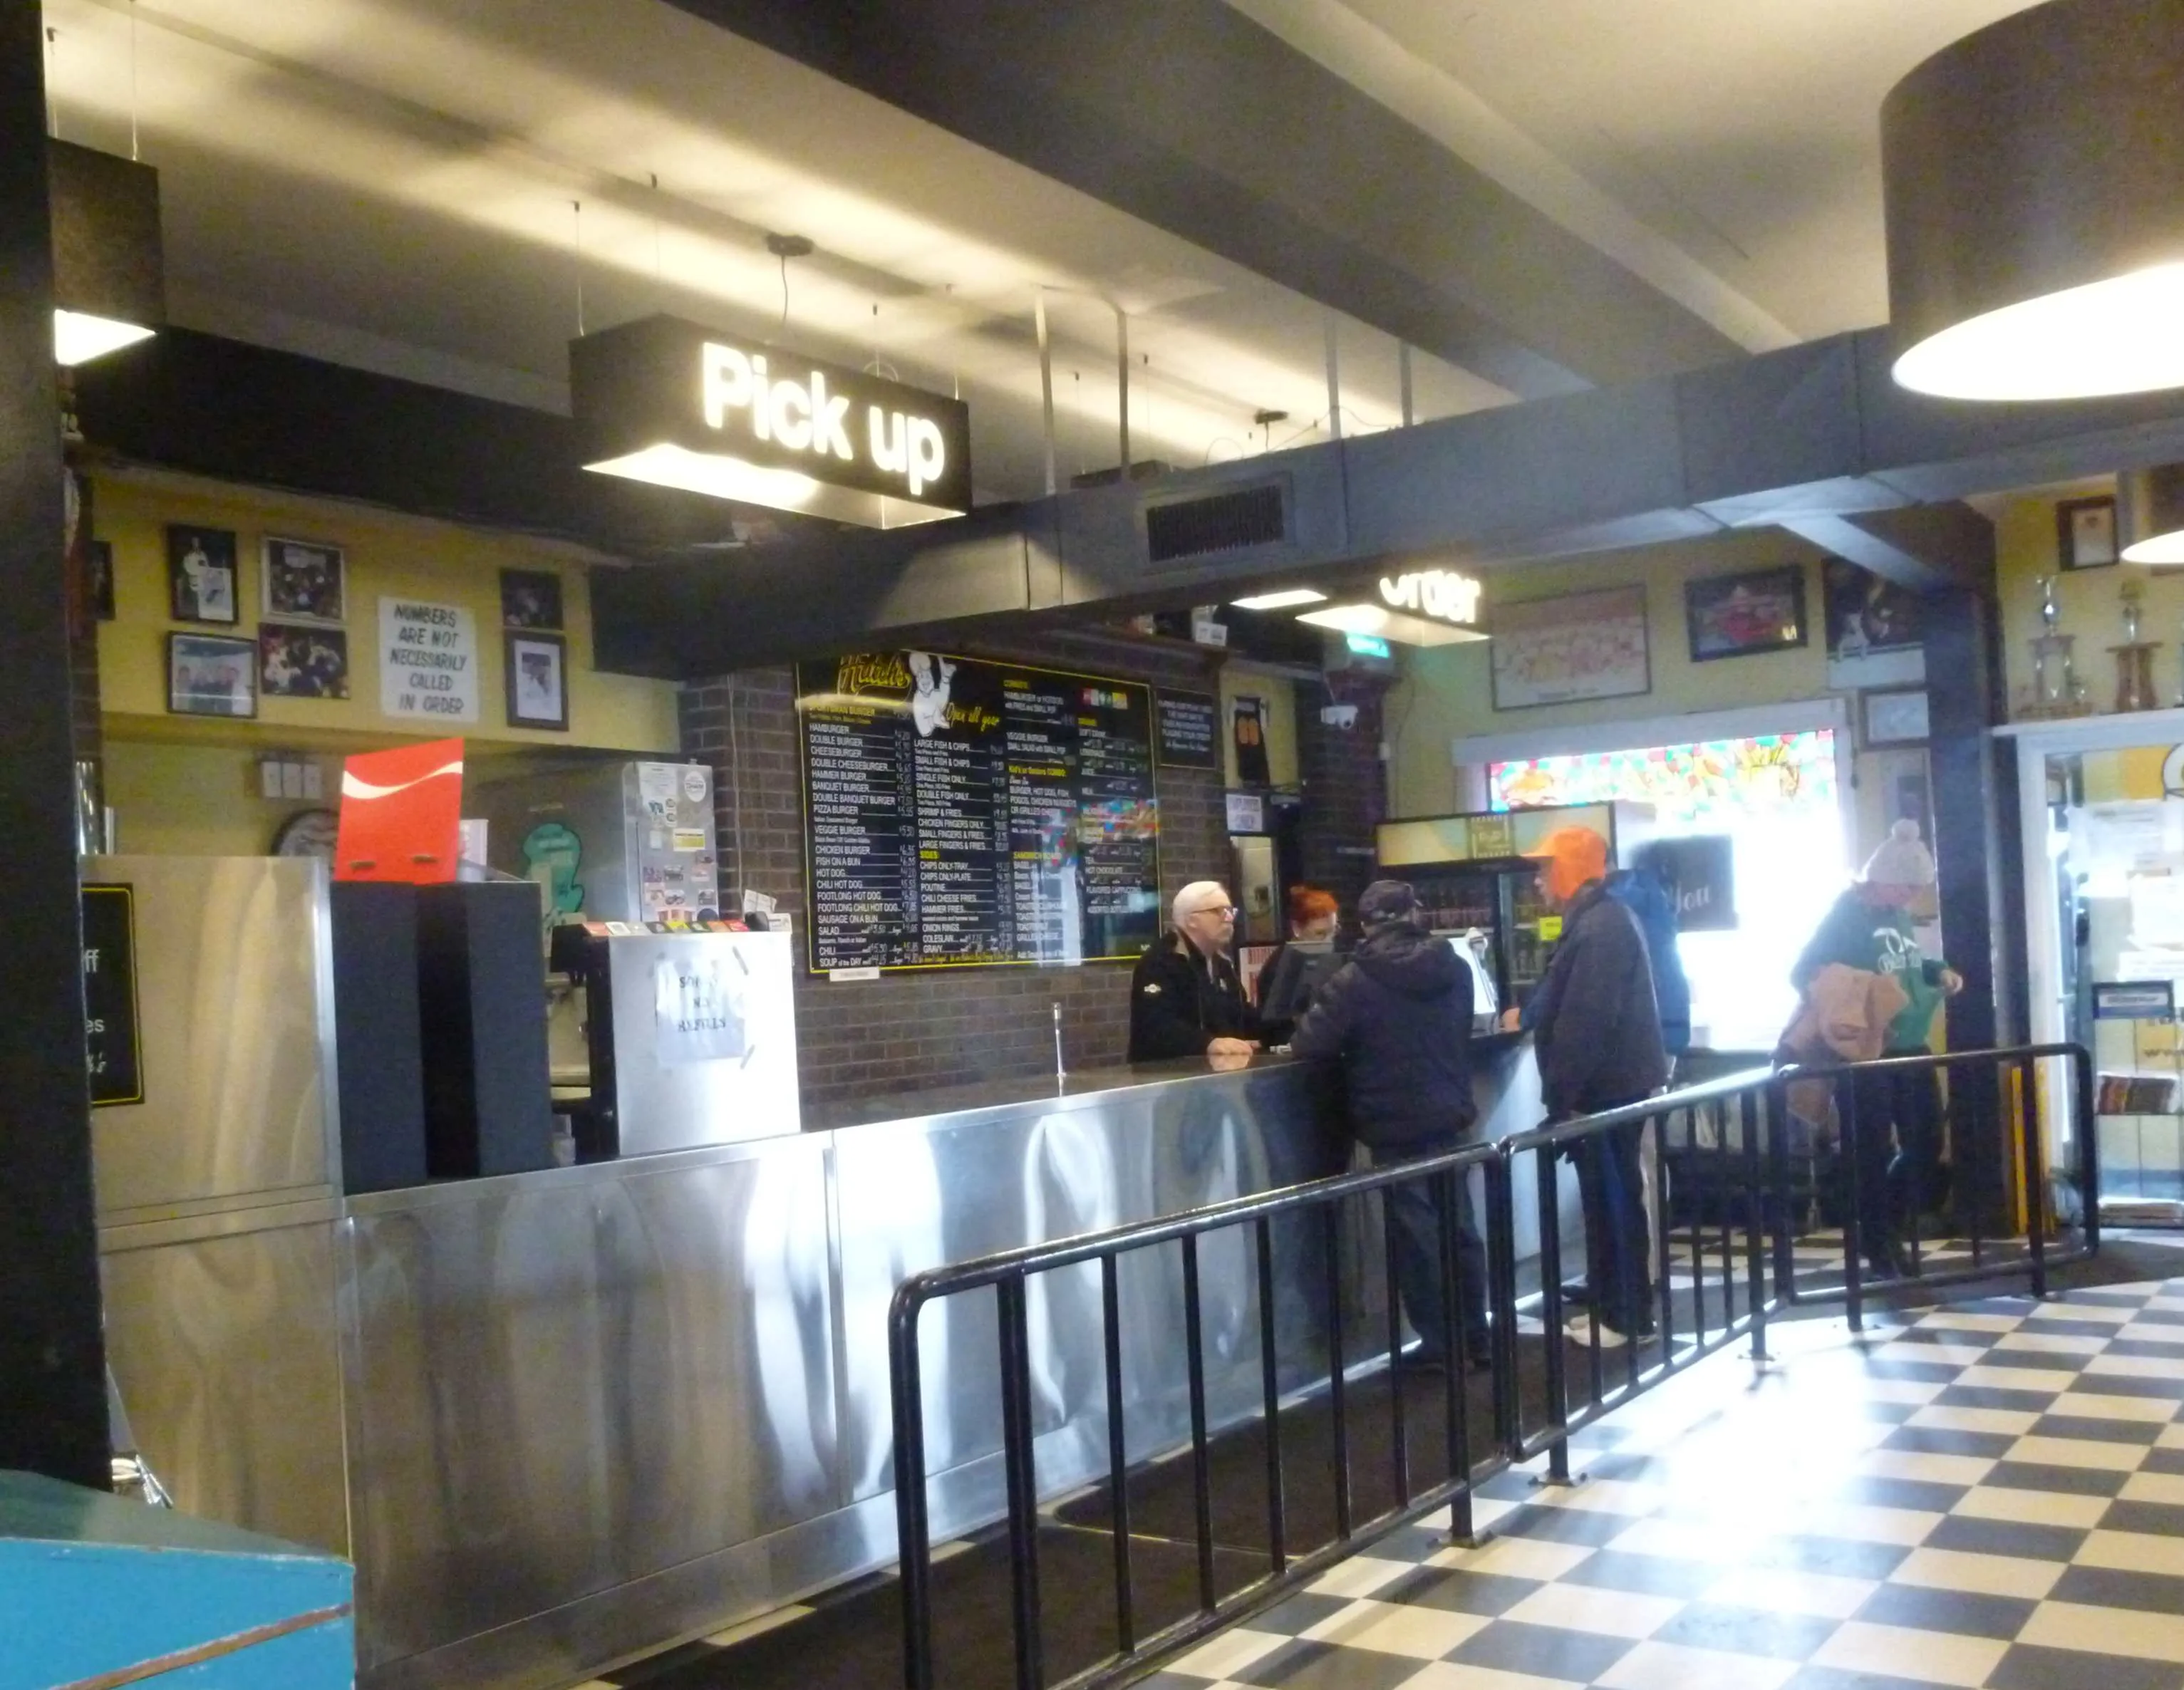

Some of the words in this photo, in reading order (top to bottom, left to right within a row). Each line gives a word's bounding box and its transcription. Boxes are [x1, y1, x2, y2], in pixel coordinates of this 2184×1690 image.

[703, 341, 854, 460] Pick
[869, 405, 945, 496] up
[394, 604, 457, 628] NUMBERS
[399, 627, 426, 645] ARE
[431, 631, 460, 648] NOT
[390, 648, 467, 671] NECESSARILY
[410, 673, 453, 691] CALLED
[399, 694, 415, 710] IN
[423, 695, 464, 714] ORDER
